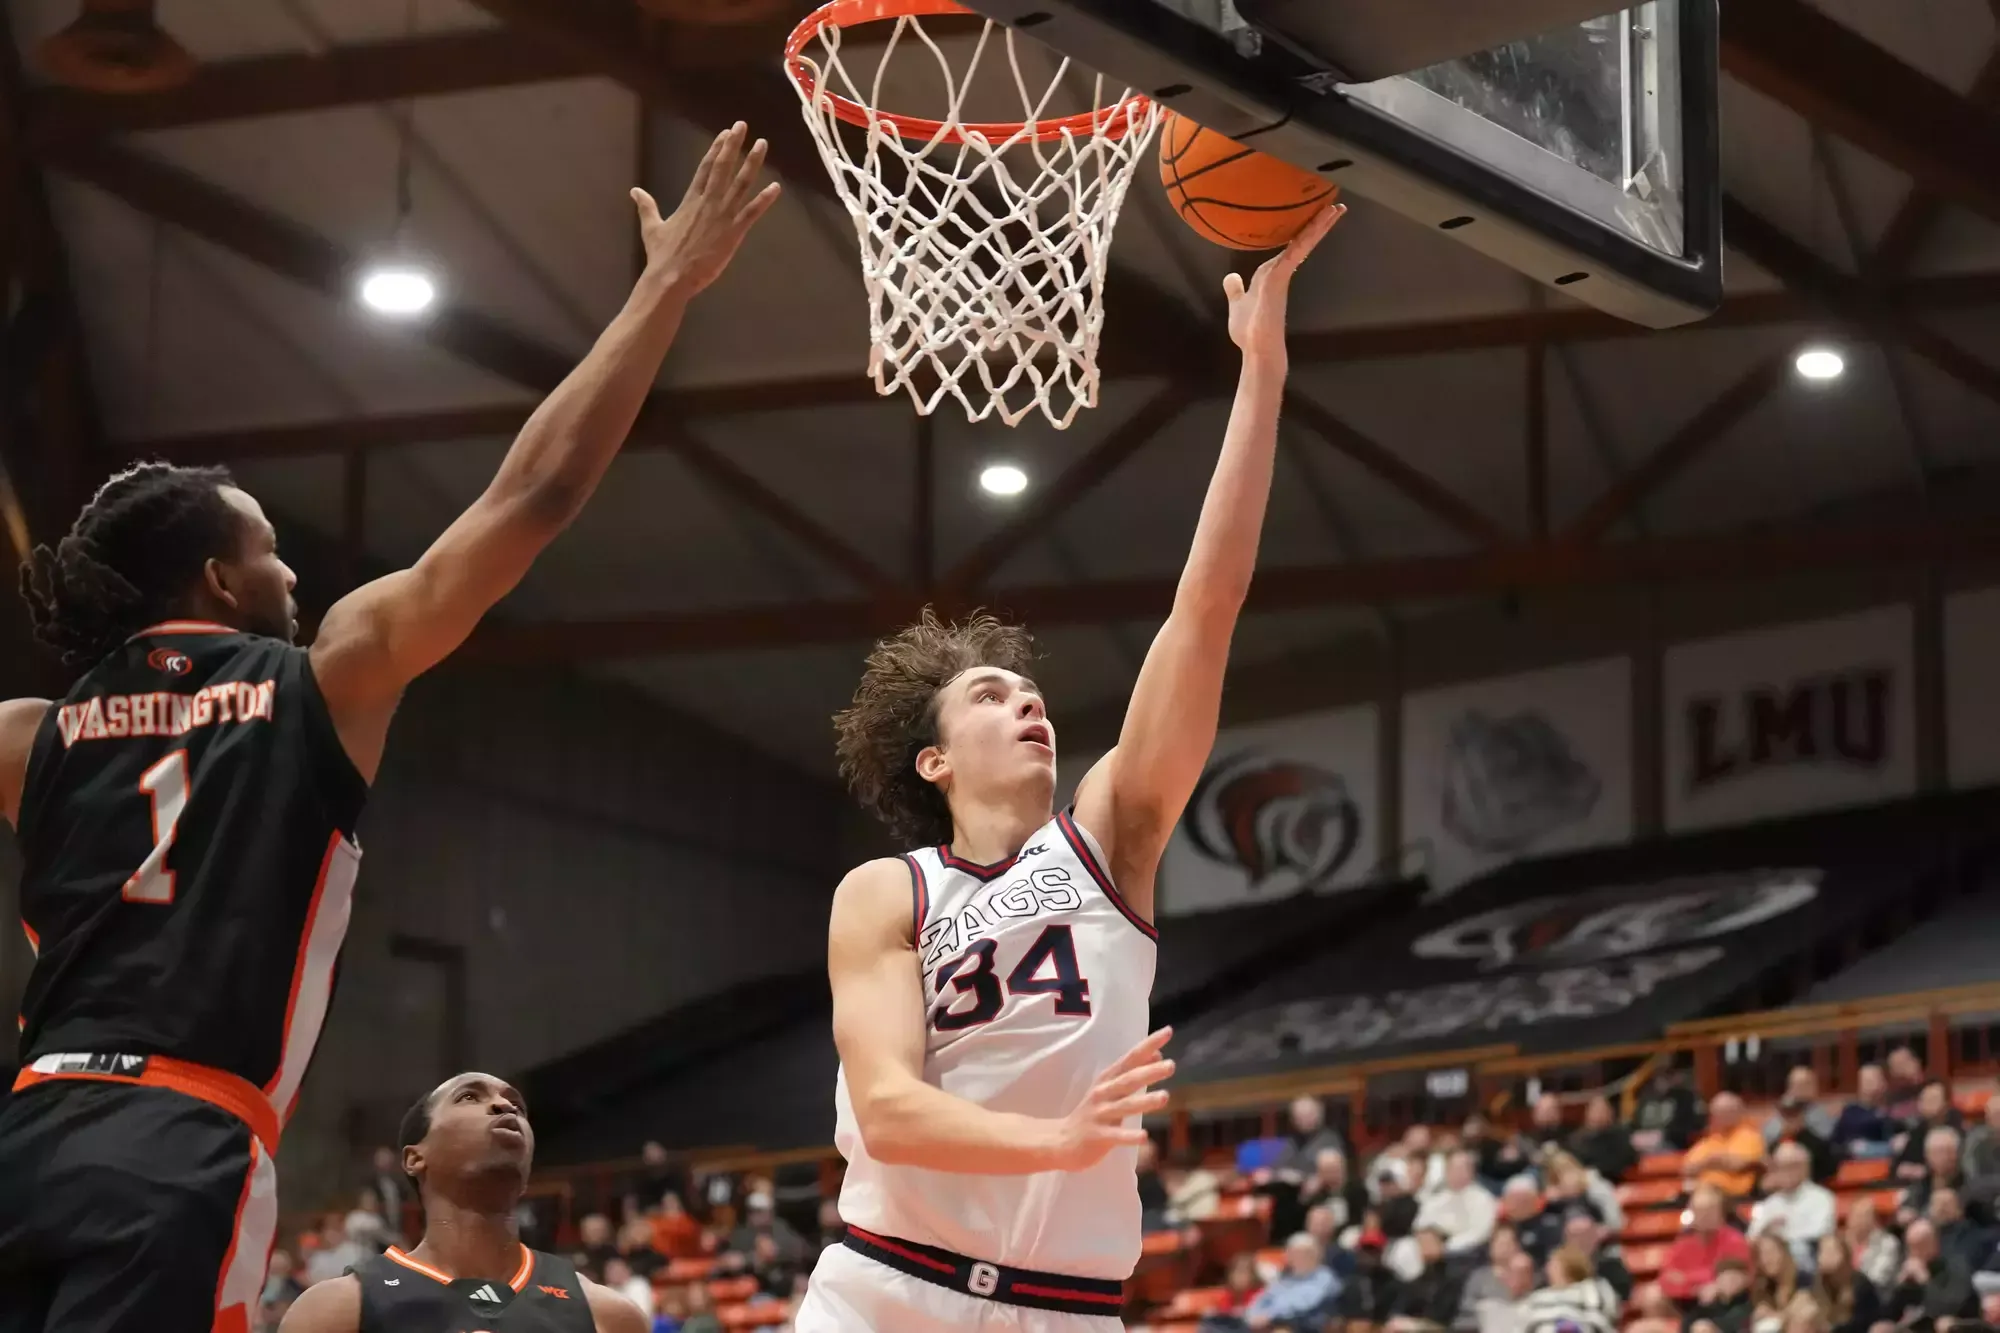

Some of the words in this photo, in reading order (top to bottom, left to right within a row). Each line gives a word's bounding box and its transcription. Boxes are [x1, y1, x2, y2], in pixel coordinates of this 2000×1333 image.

[57, 679, 276, 749] WASHINGTON
[1686, 668, 1894, 790] LMU
[121, 748, 191, 904] 1
[919, 867, 1082, 978] ZAGS
[934, 924, 1092, 1032] 34
[967, 1262, 1000, 1297] G
